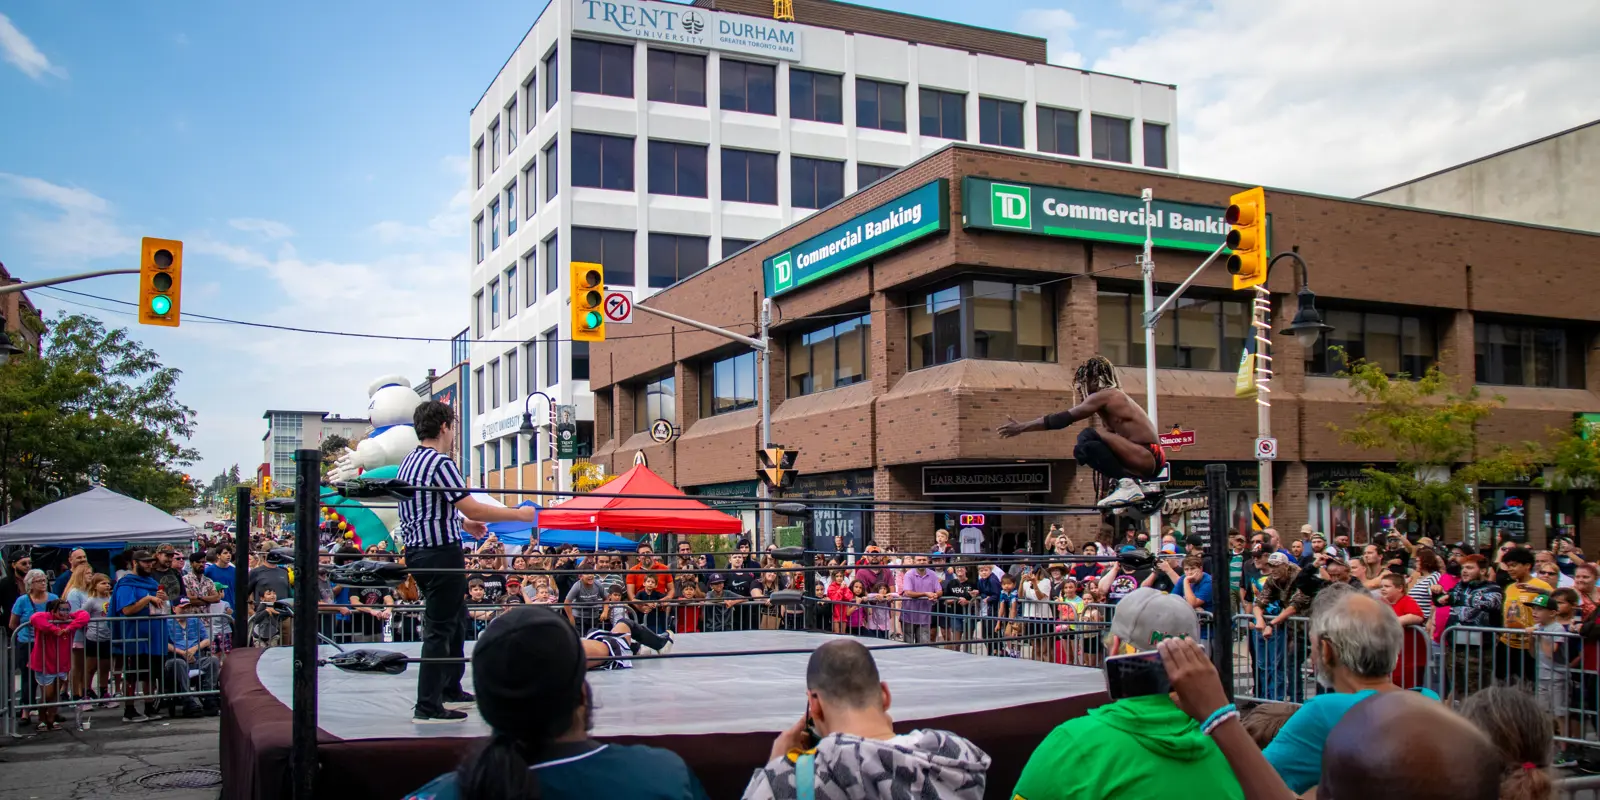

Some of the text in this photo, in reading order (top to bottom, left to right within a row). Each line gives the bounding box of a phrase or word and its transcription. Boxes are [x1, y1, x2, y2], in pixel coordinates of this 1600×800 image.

[582, 1, 678, 31] TRENT
[635, 29, 704, 45] UNIVERSITY
[719, 20, 794, 45] DURHAM
[719, 37, 794, 53] GREATER TORONTO AREA
[995, 191, 1027, 219] TD
[1042, 198, 1233, 236] Commercial Bankin
[796, 203, 922, 269] Commercial Banking
[775, 261, 790, 284] TD
[499, 415, 520, 432] UNIVERSITY
[930, 473, 1044, 485] HAIR BRAIDING STUDIO
[825, 519, 854, 536] STYLE
[962, 515, 983, 524] OPEN
